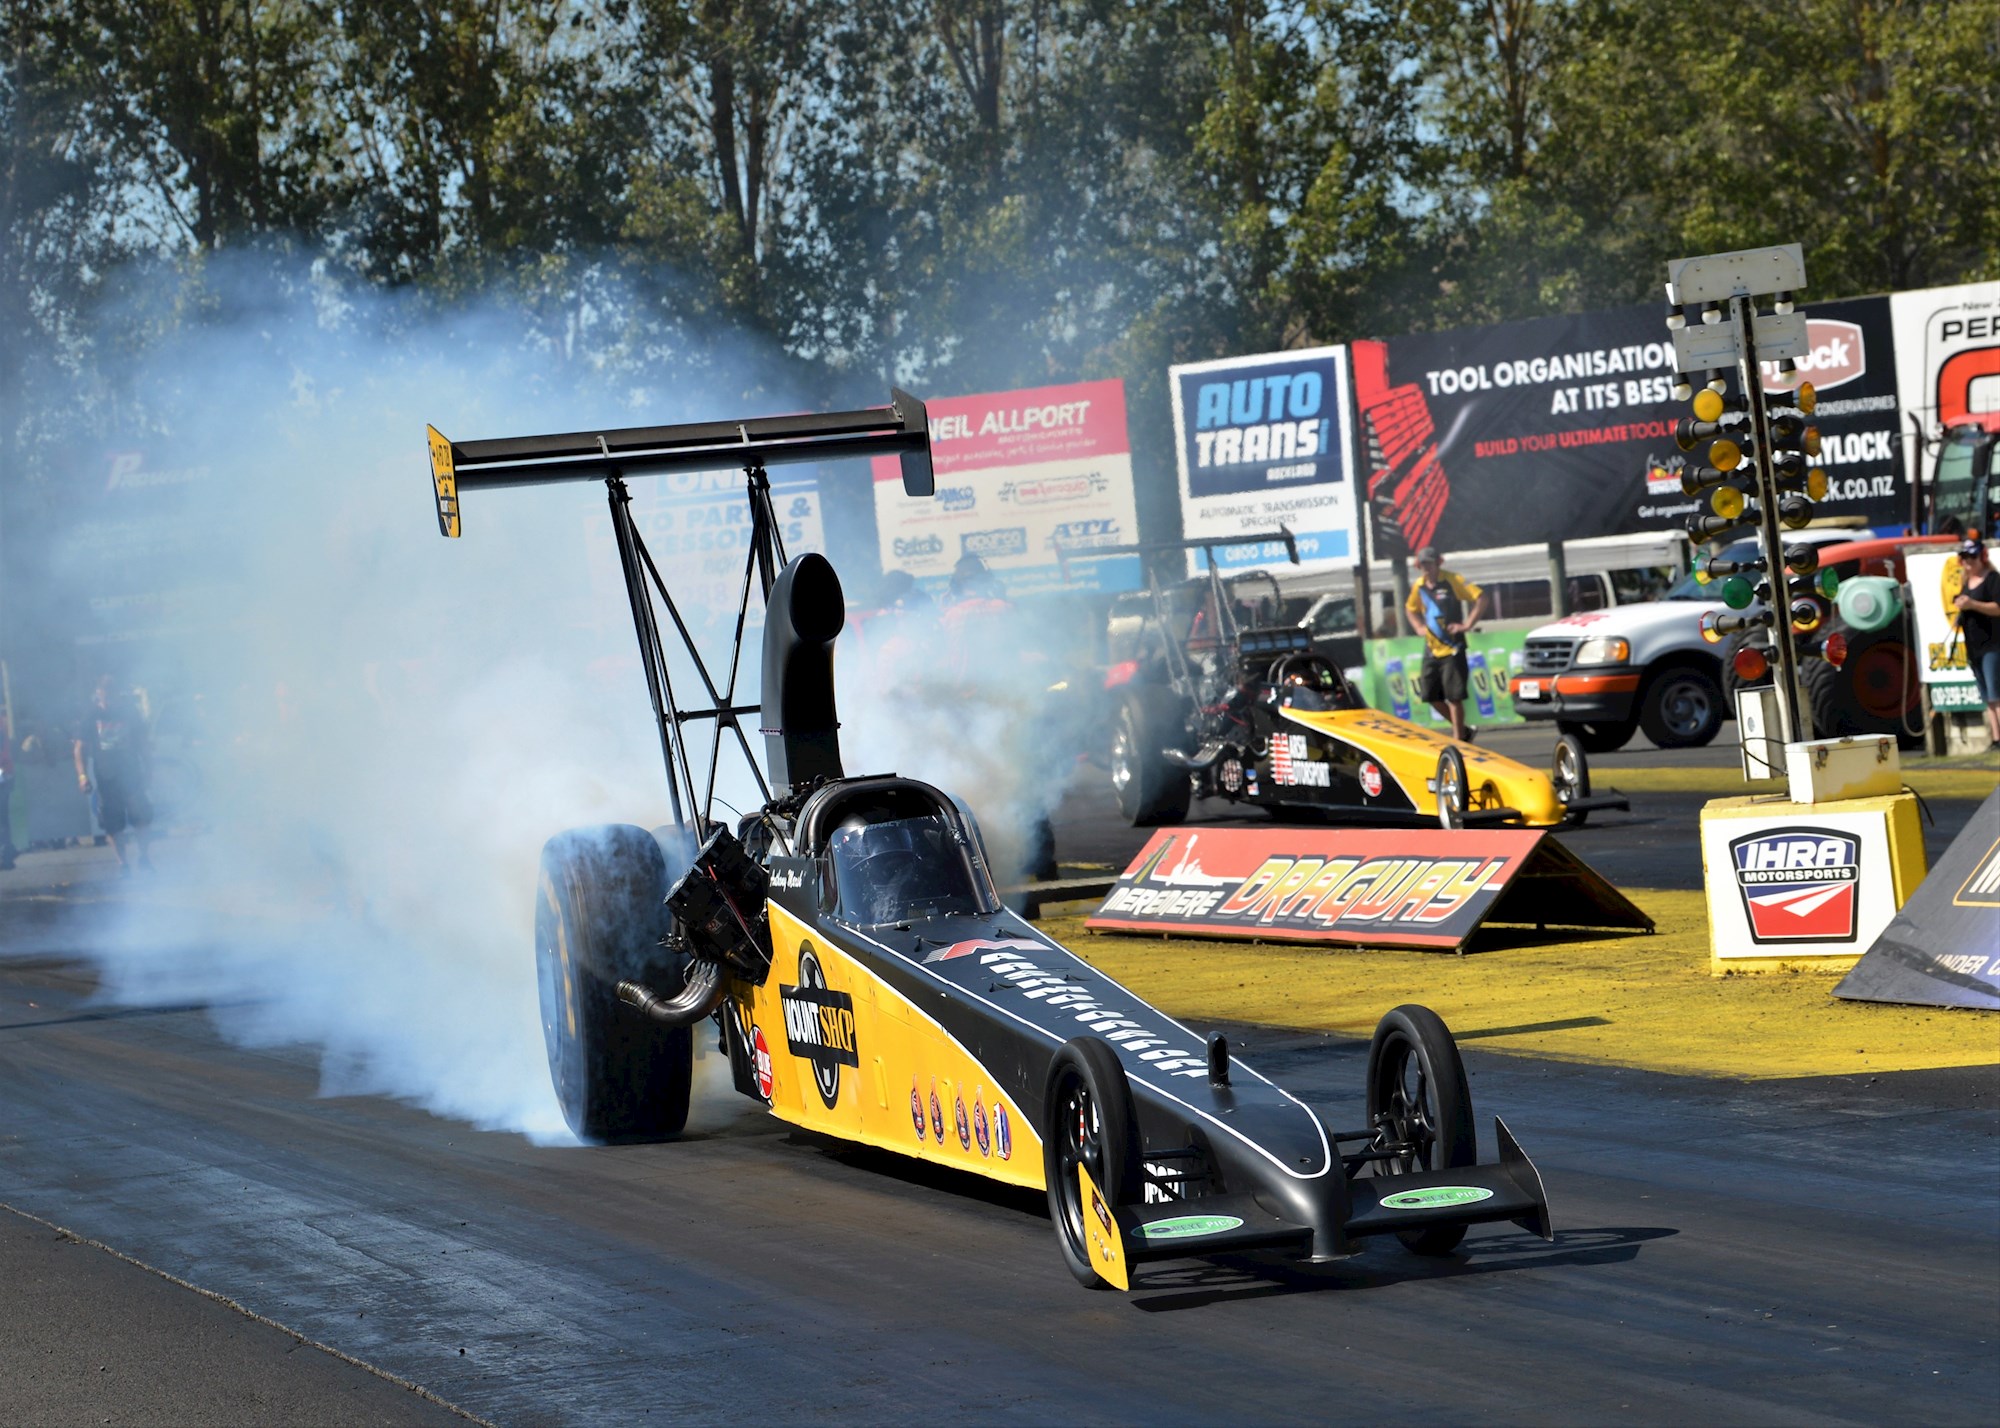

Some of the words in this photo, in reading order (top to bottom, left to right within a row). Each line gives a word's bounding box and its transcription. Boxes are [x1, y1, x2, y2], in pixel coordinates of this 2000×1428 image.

[1427, 366, 1492, 396] TOOL
[1494, 341, 1679, 387] ORGANISATION
[1196, 371, 1322, 430] AUTO
[1551, 388, 1580, 415] AT
[1585, 382, 1621, 411] ITS
[1625, 375, 1677, 406] BEST
[927, 414, 974, 441] NEIL
[979, 400, 1092, 437] ALLPORT
[1475, 438, 1518, 458] BUILD
[1520, 433, 1557, 452] YOUR
[1559, 424, 1629, 447] ULTIMATE
[1629, 420, 1668, 439] TOOL
[788, 495, 811, 518] &
[1745, 839, 1847, 870] IHRA
[1100, 886, 1225, 918] MEREMERE
[1217, 855, 1506, 927] DRAGWAY
[1744, 868, 1852, 882] MOTORSPORTS
